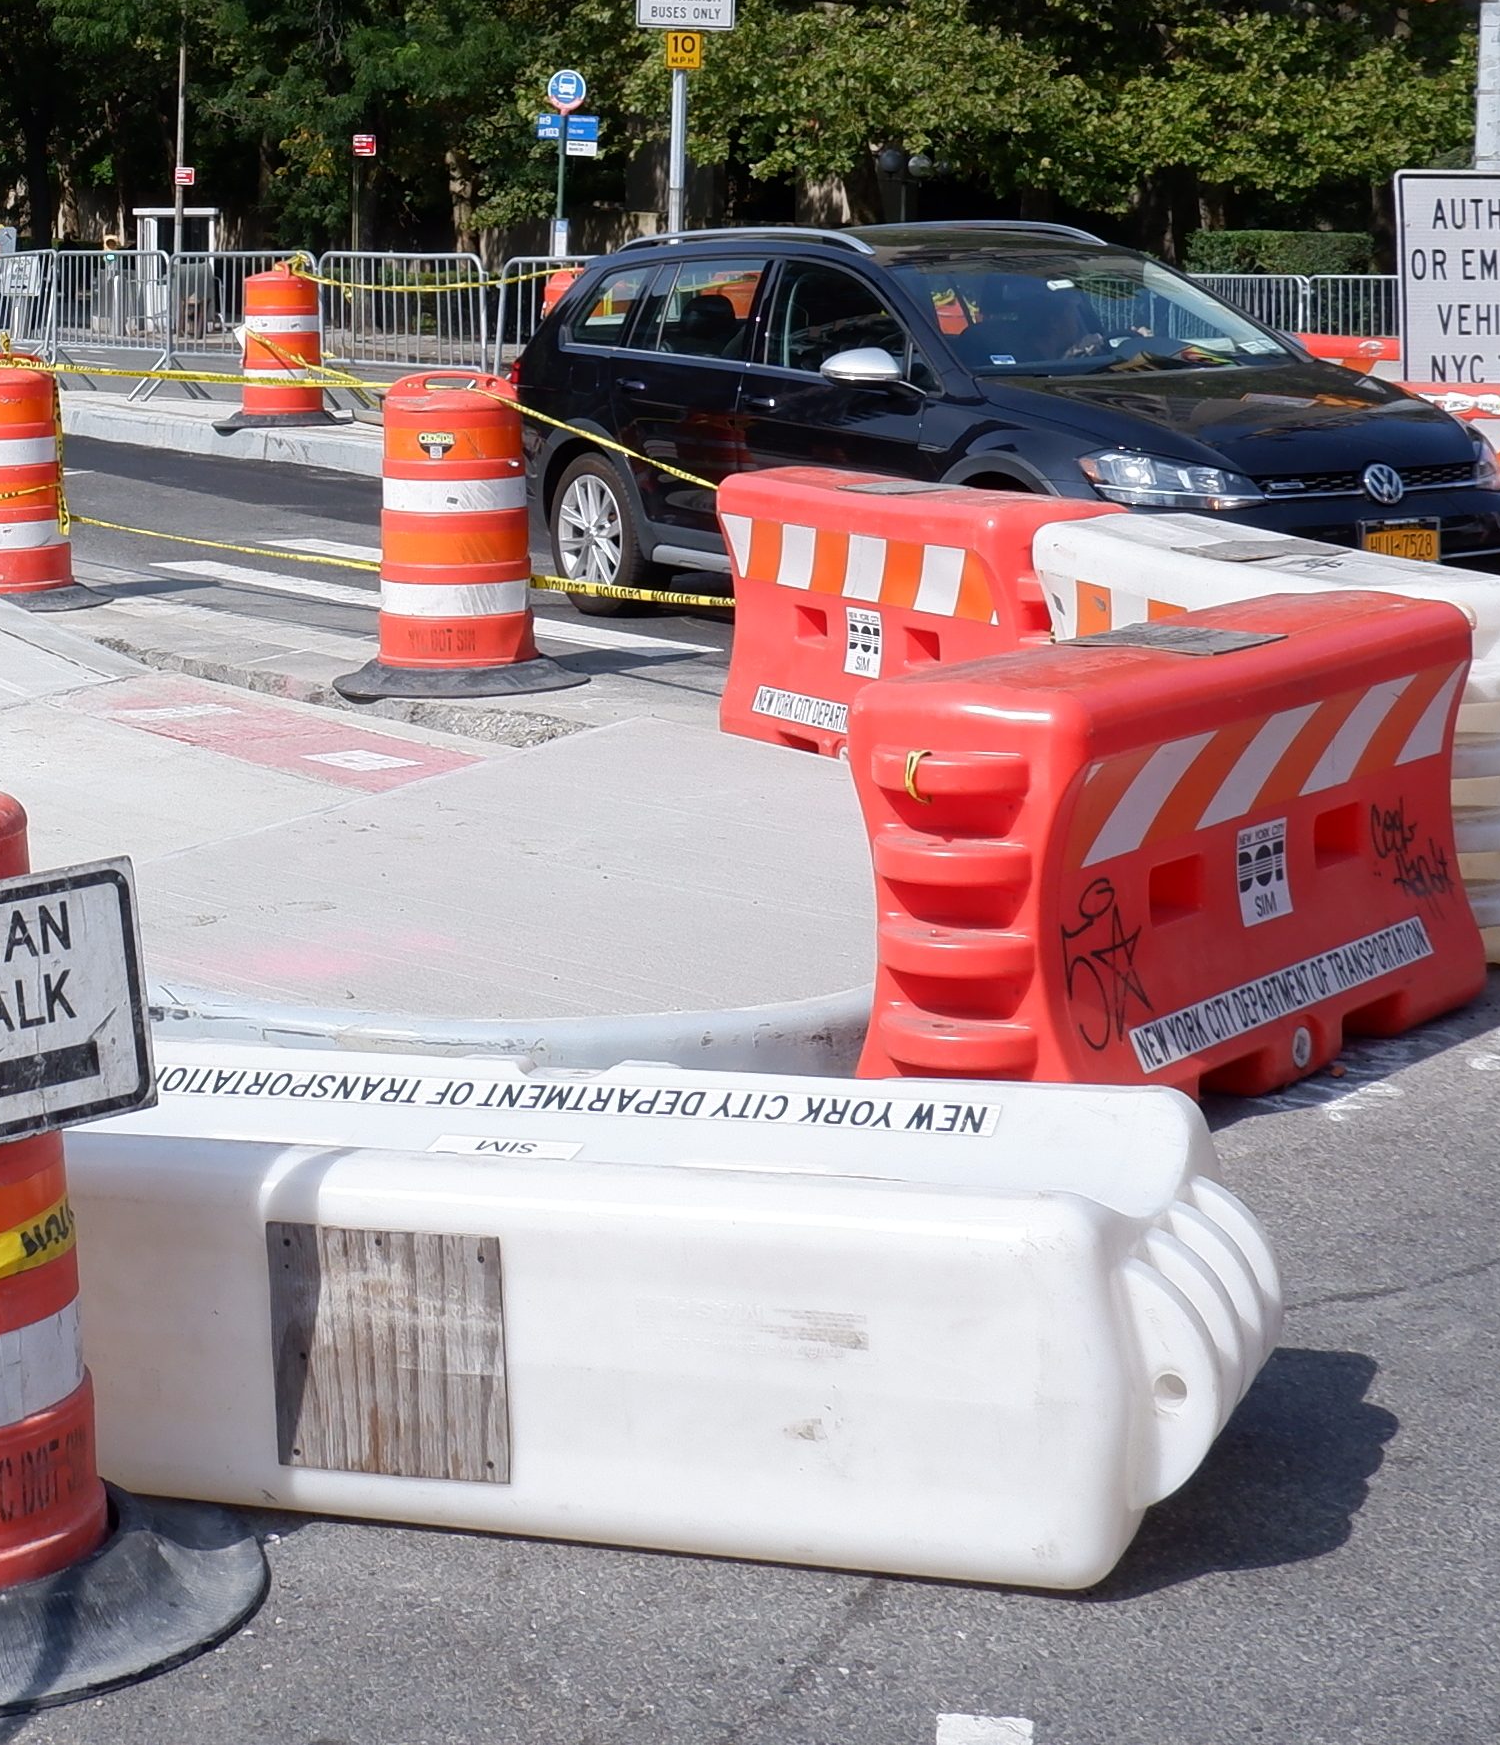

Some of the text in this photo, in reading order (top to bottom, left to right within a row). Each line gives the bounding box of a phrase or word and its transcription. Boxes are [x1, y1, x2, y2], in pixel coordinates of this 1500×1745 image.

[651, 6, 721, 19] BUSES ONLY
[673, 35, 696, 53] 10
[1411, 249, 1448, 281] OR
[1431, 354, 1484, 383] NYC
[1402, 533, 1433, 558] 7528
[855, 656, 870, 672] SIM
[755, 688, 848, 731] NEW YORK CITY DEPART
[1254, 828, 1270, 840] YORK
[1271, 823, 1284, 835] CITY
[1238, 840, 1284, 893] DOT
[1255, 891, 1278, 917] SIM
[1134, 918, 1428, 1069] NEW YORK CITY DEPARTMENT OF TRANSPORTATION
[157, 1066, 988, 1132] NEW YORK CITY DEPARTMENT OF TRANSPORTATIO
[475, 1140, 538, 1154] SIM
